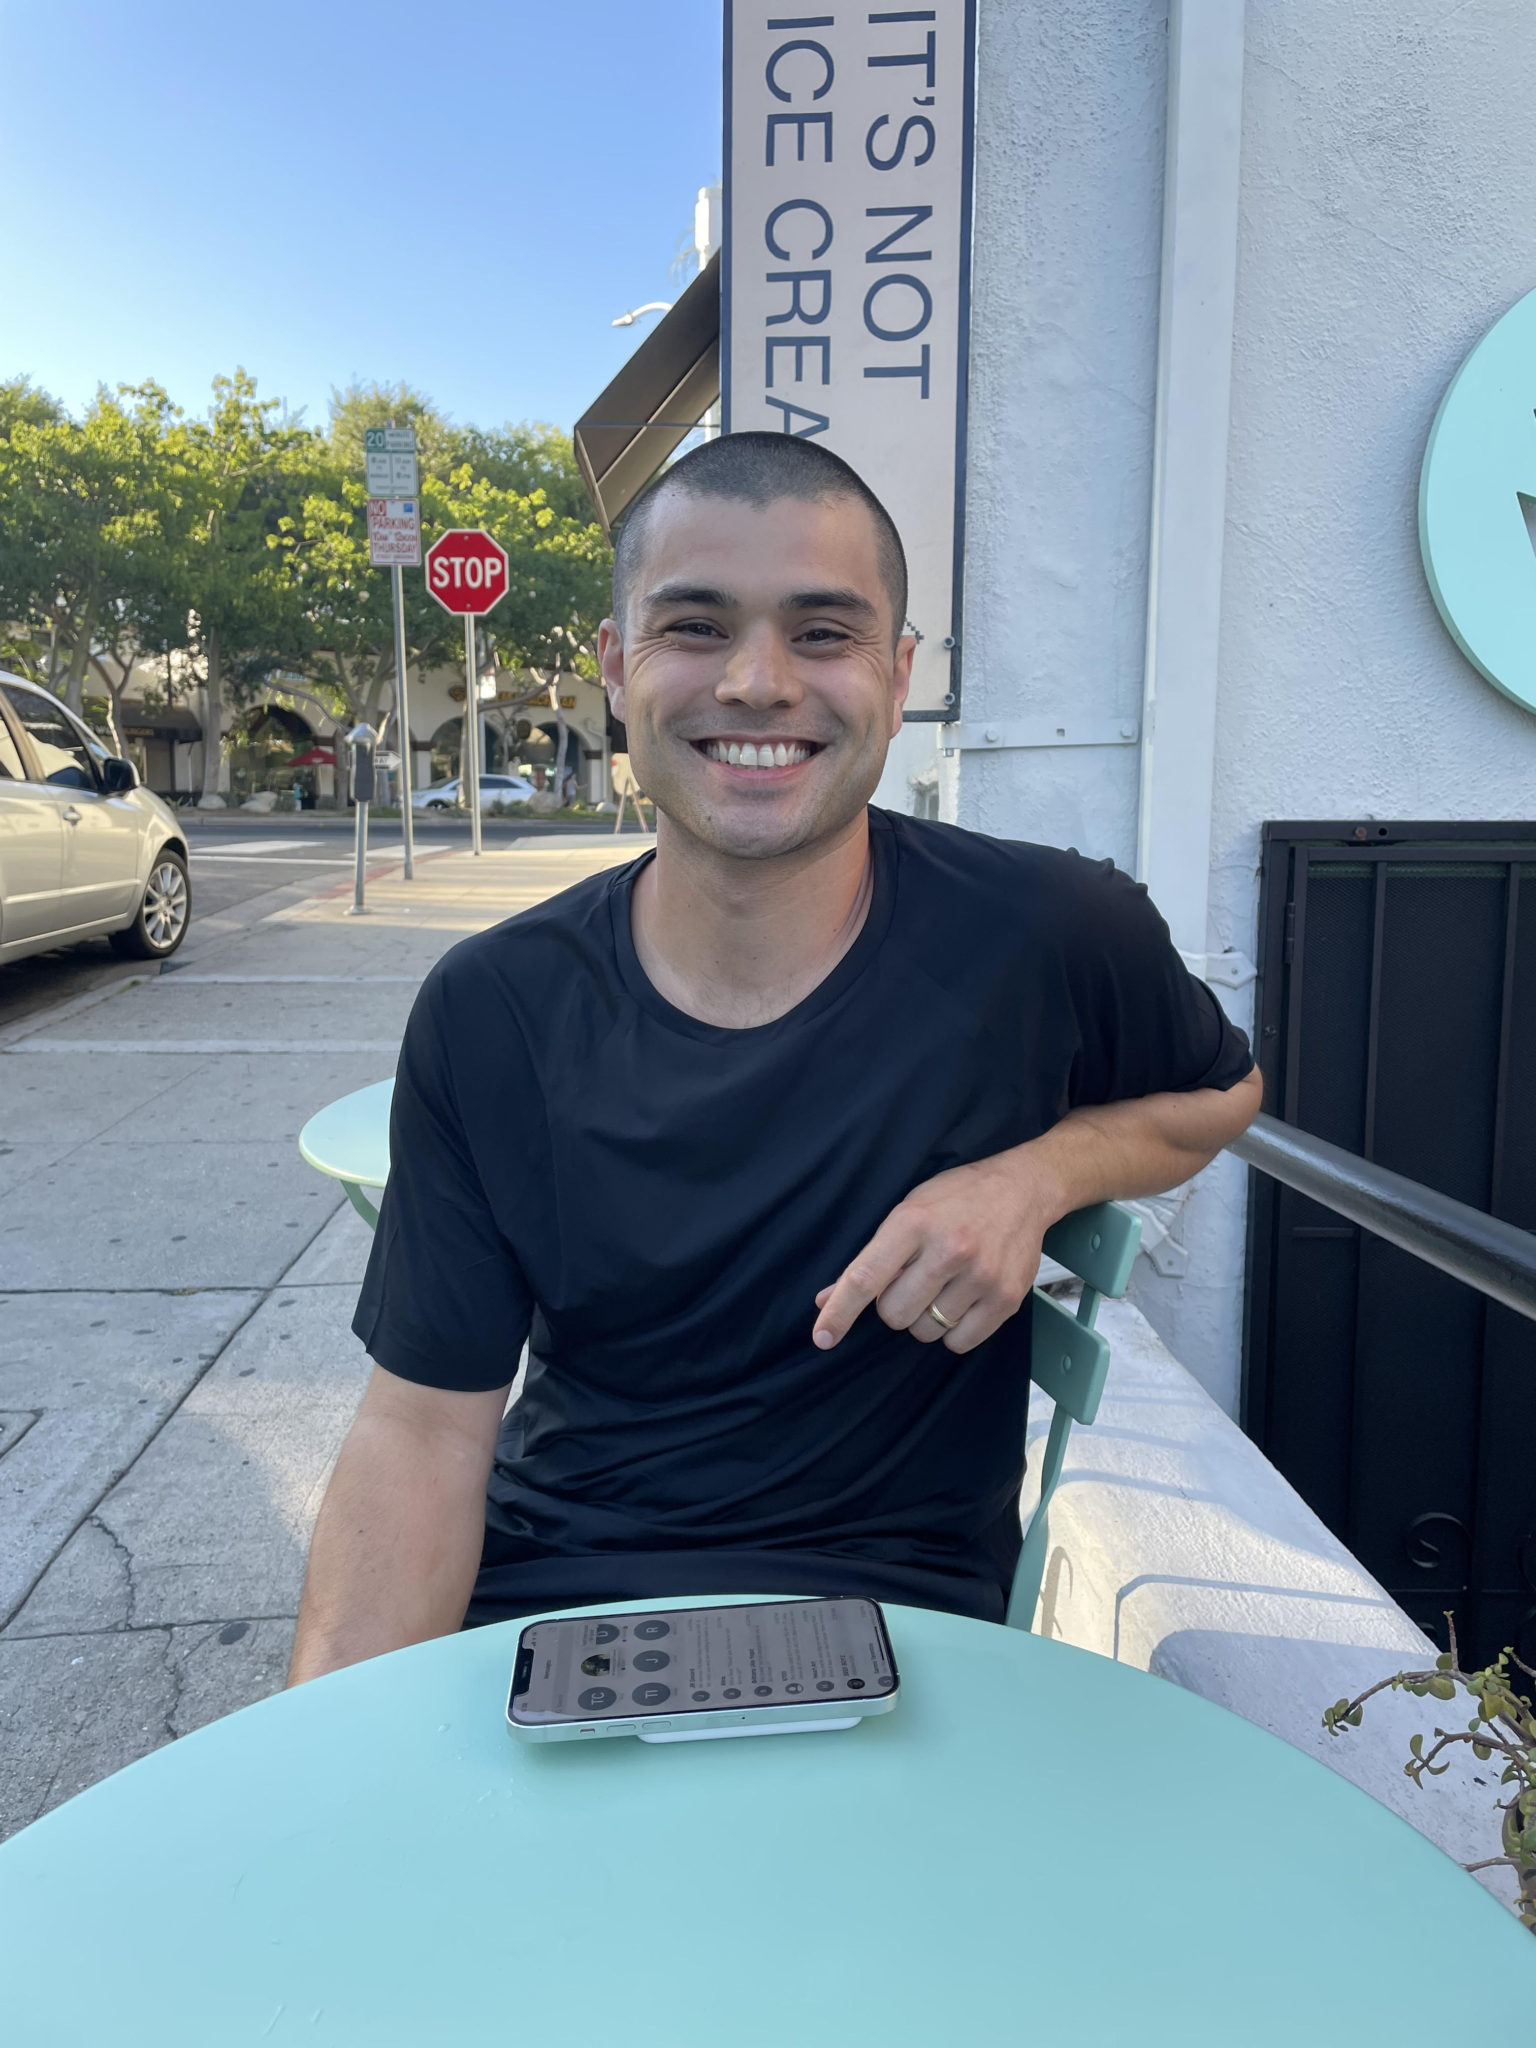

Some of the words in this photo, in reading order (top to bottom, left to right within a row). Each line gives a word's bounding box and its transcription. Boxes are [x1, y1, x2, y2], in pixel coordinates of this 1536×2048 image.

[765, 16, 835, 167] ICE
[865, 10, 936, 171] IT'S
[863, 205, 933, 400] NOT
[367, 431, 384, 447] 20
[370, 500, 386, 515] NO
[372, 517, 415, 529] PARKING
[373, 542, 416, 553] THURSDAY
[432, 556, 503, 589] STOP
[591, 1692, 605, 1706] TC
